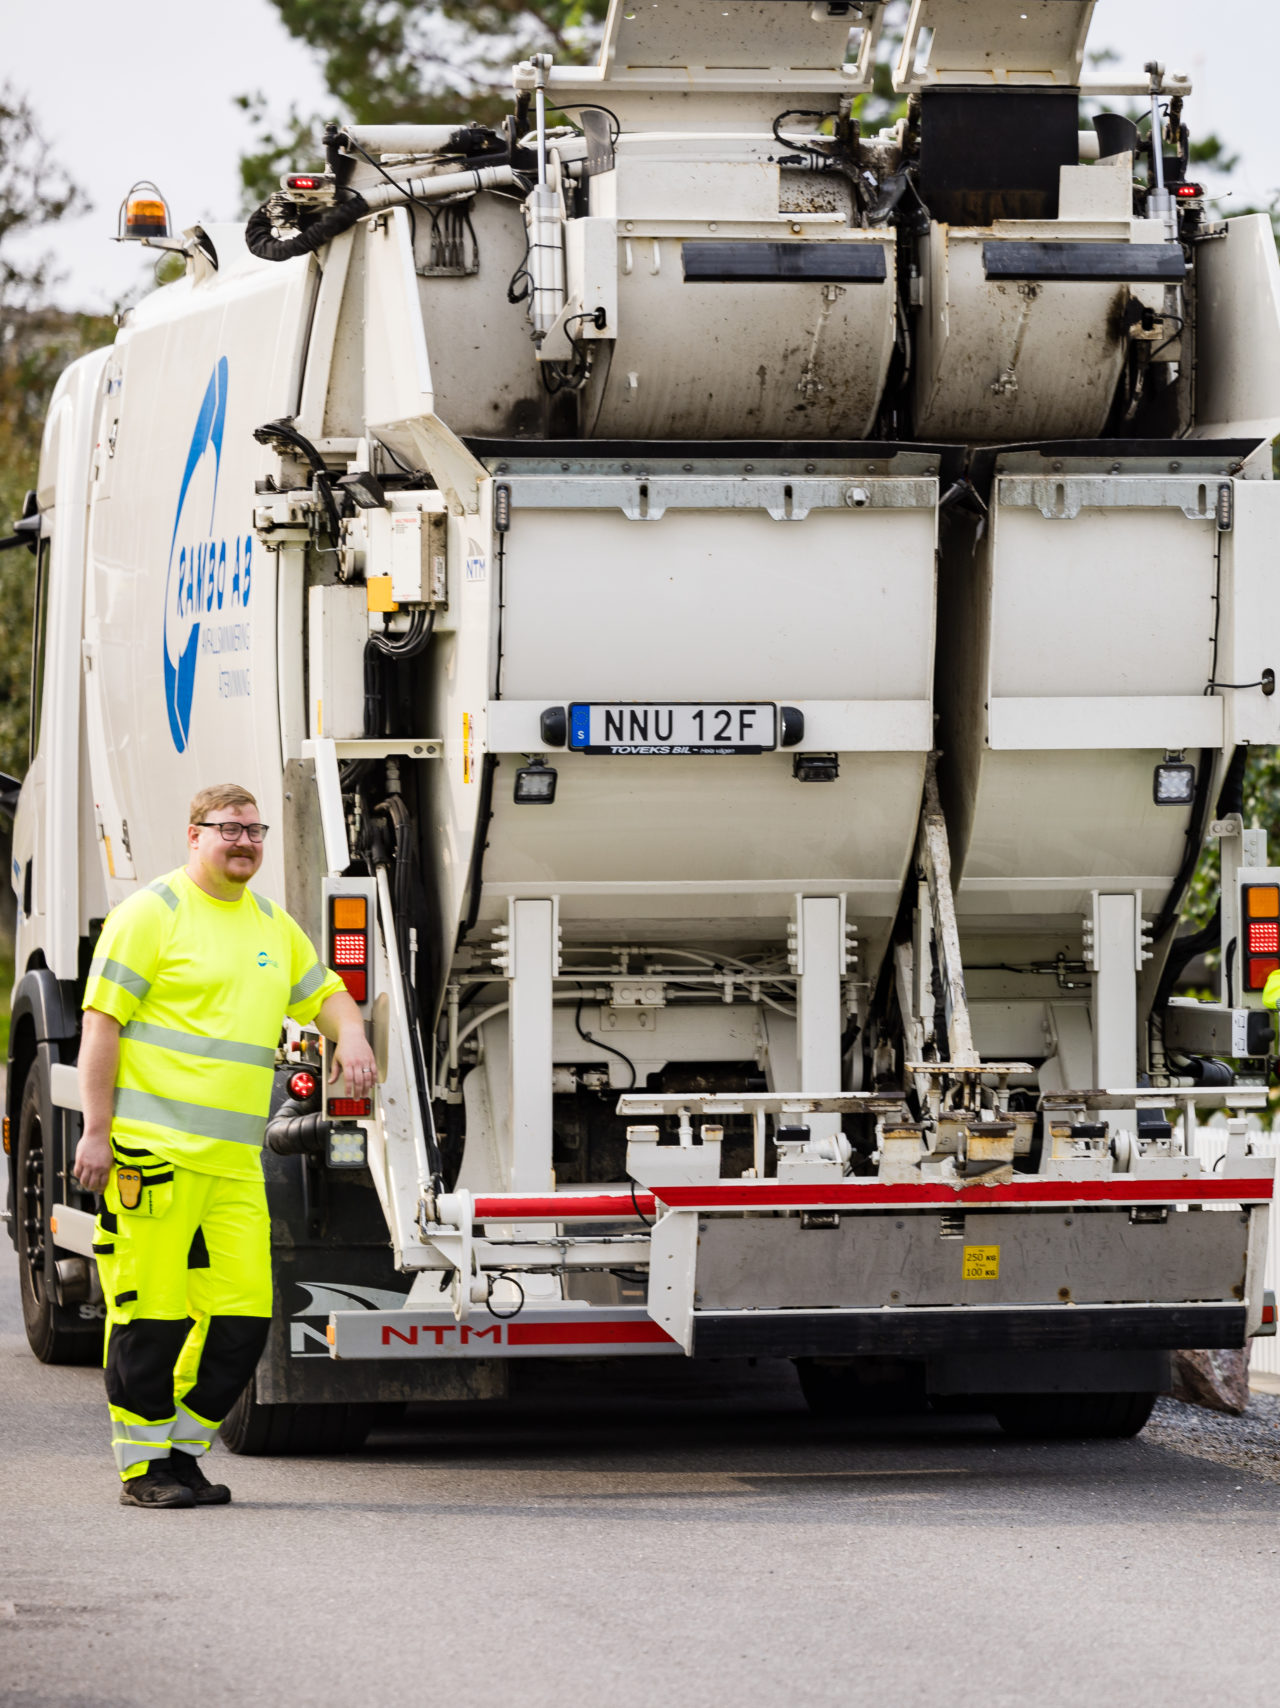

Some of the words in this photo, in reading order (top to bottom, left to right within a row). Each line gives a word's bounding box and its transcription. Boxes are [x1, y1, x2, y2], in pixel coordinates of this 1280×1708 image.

[177, 537, 226, 619] RAMBO
[231, 535, 252, 607] AB
[466, 559, 486, 579] NTM
[577, 730, 585, 740] S
[604, 709, 673, 741] NNU
[691, 709, 757, 741] 12F
[610, 746, 671, 754] TOVEKS
[671, 746, 692, 754] BIL
[966, 1268, 983, 1276] 100
[381, 1324, 503, 1346] NTM
